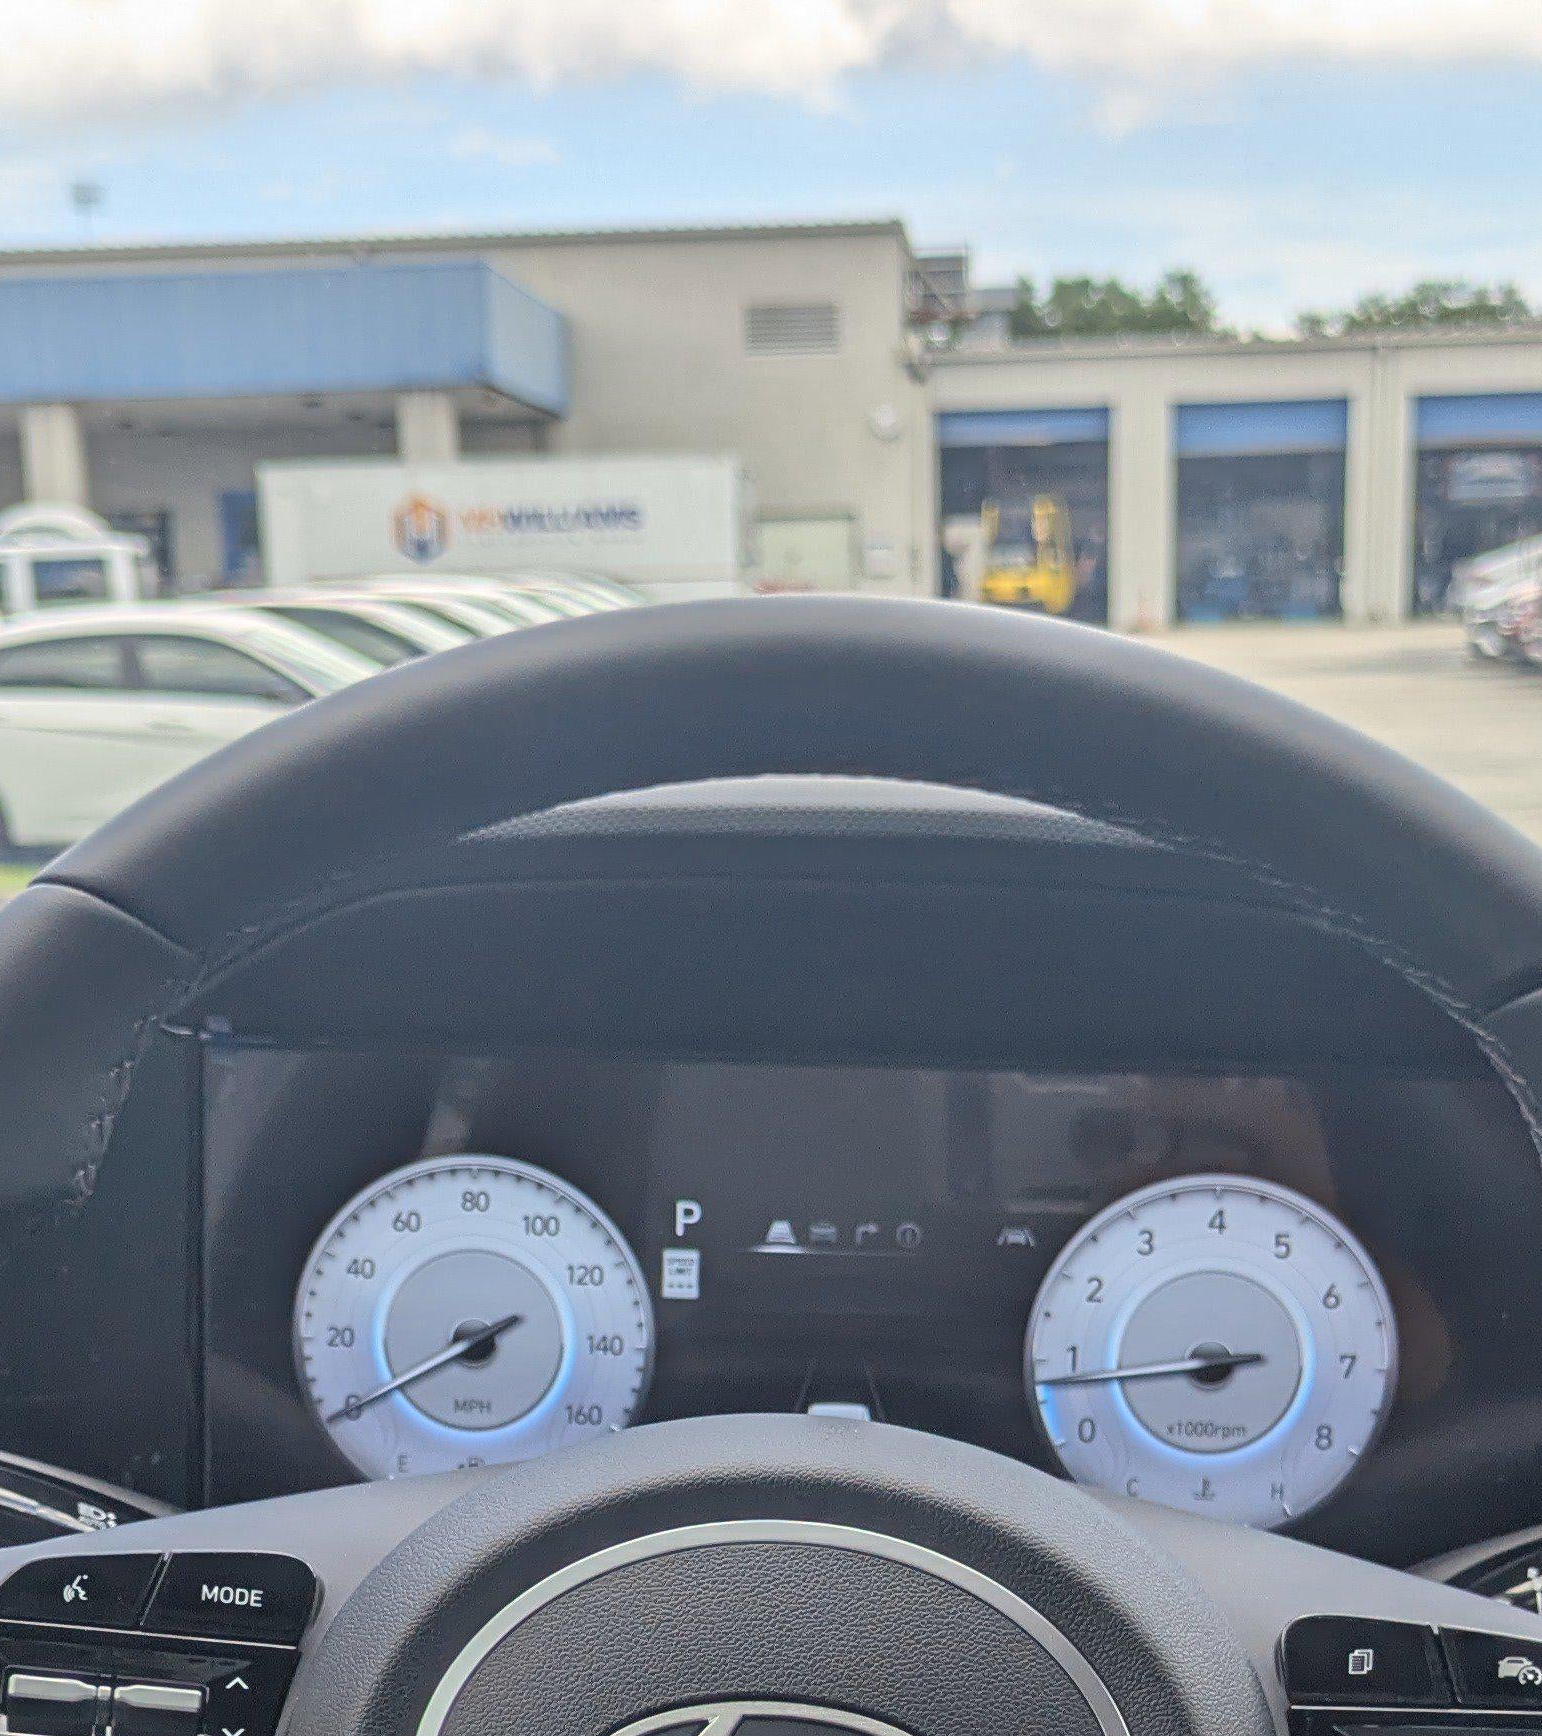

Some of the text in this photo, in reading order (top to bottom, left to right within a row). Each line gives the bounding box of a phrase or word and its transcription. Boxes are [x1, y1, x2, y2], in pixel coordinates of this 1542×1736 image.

[460, 1190, 490, 1212] 80
[391, 1211, 421, 1234] 60
[523, 1215, 560, 1237] 100
[675, 1200, 702, 1236] P
[1207, 1208, 1227, 1235] 4
[1137, 1230, 1155, 1256] 3
[1274, 1233, 1291, 1259] 5
[346, 1258, 376, 1279] 40
[566, 1264, 604, 1287] 120
[1086, 1277, 1104, 1303] 2
[1322, 1283, 1341, 1310] 6
[327, 1326, 355, 1348] 20
[586, 1333, 624, 1356] 140
[1066, 1345, 1079, 1373] 1
[1338, 1354, 1357, 1379] 7
[454, 1398, 491, 1412] MPH
[564, 1404, 602, 1426] 160
[1077, 1417, 1097, 1443] 0
[1165, 1421, 1248, 1438] x1000rpm
[1314, 1424, 1334, 1451] 8
[398, 1455, 408, 1473] E
[1125, 1477, 1139, 1497] C
[1270, 1482, 1284, 1500] H
[200, 1584, 264, 1608] MODE
